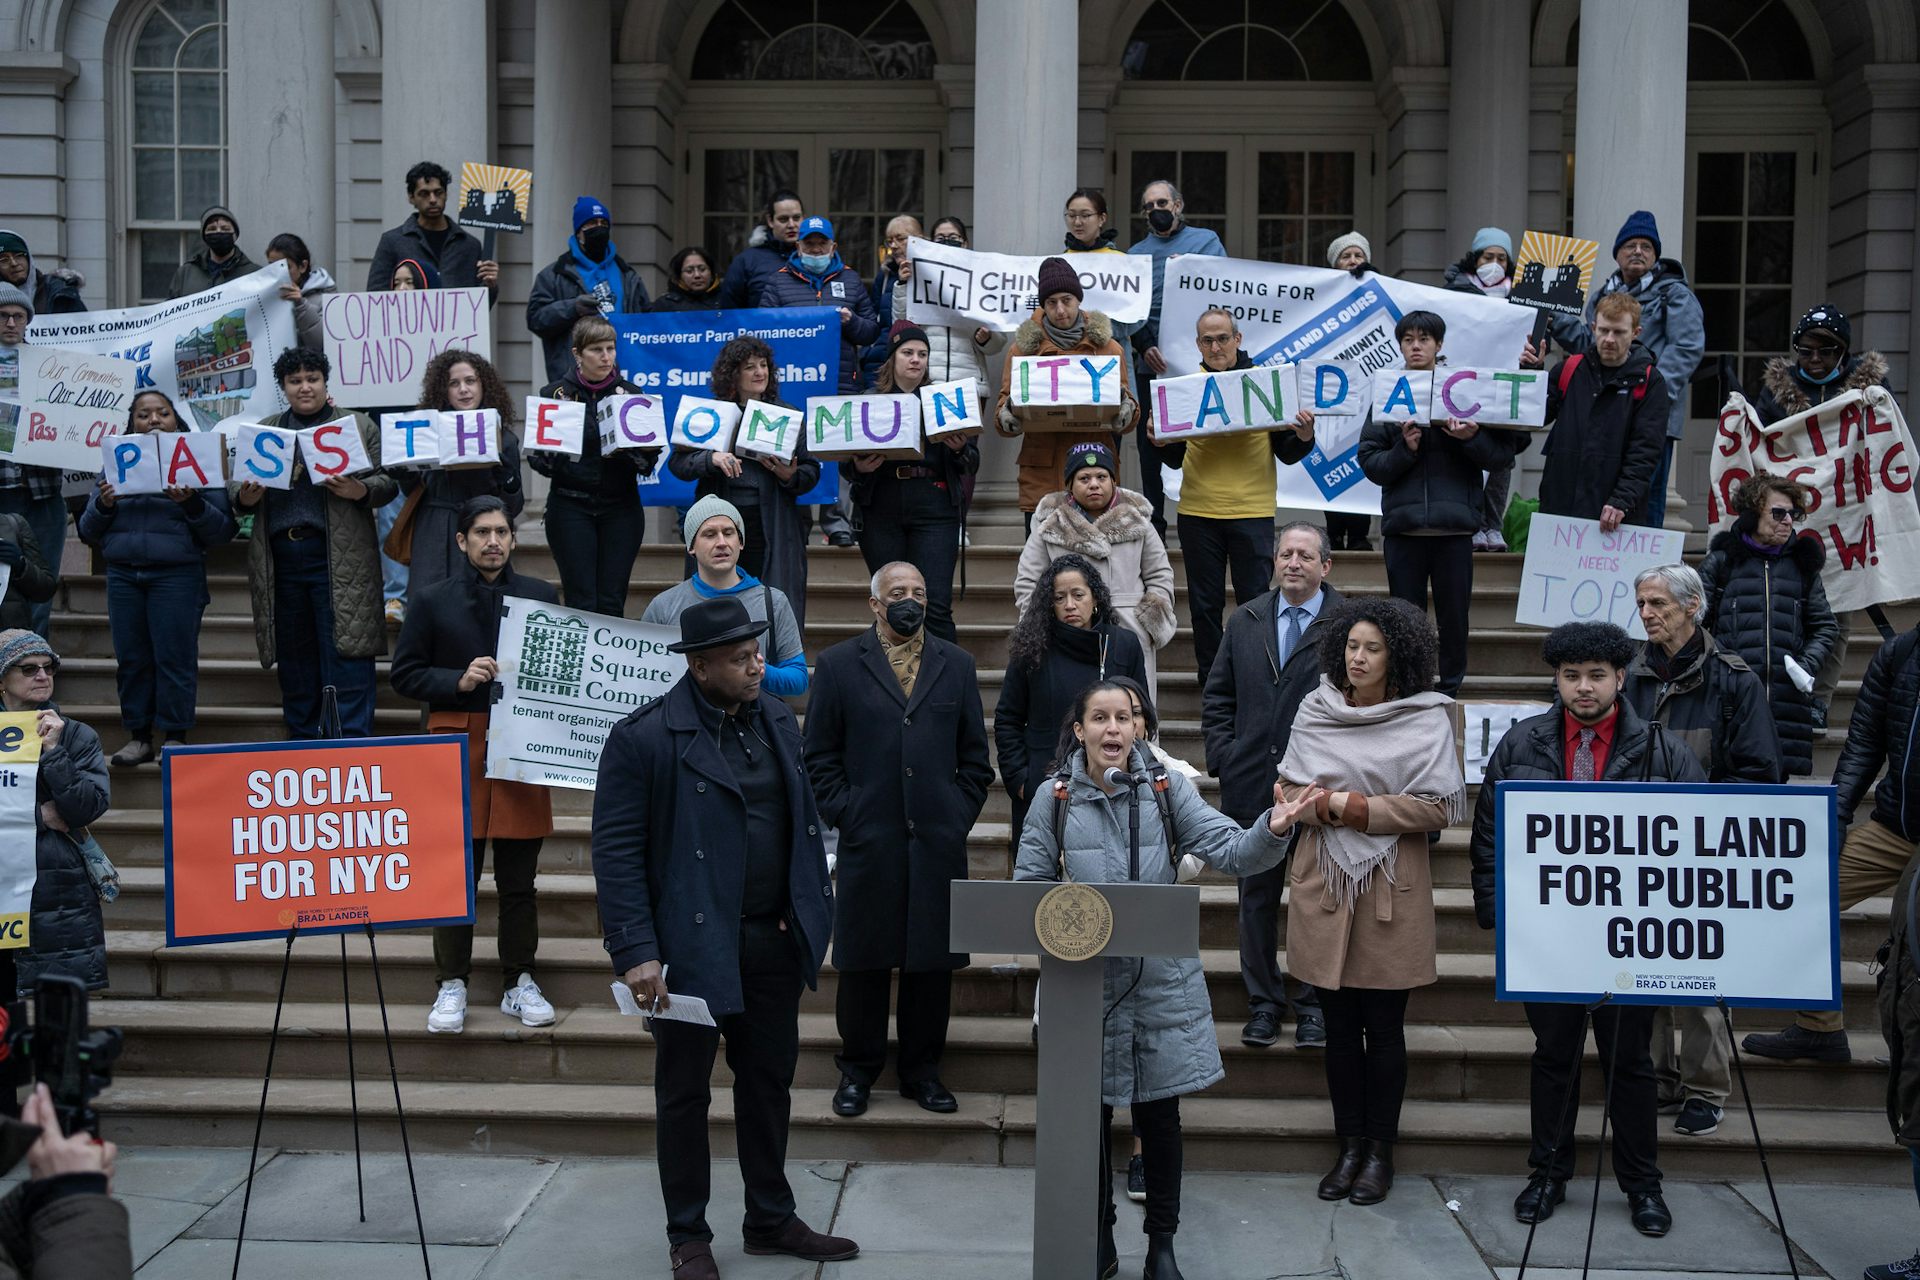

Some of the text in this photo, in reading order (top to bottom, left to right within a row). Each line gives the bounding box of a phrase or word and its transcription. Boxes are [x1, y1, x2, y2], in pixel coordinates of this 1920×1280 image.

[980, 271, 1141, 294] CHINOWN
[1179, 275, 1315, 301] HOUSING FOR
[30, 327, 60, 337] NEW
[62, 324, 96, 336] YORK
[98, 311, 165, 332] COMMUNITY
[164, 301, 190, 319] LAND
[191, 291, 223, 308] TRUST
[324, 289, 486, 341] COMMUNITY
[979, 294, 1021, 313] CLT
[1510, 295, 1581, 313] New Economy Project
[623, 332, 702, 345] “Perseverar
[705, 330, 735, 343] Para
[1283, 327, 1325, 359] LAND
[1321, 317, 1341, 334] IS
[1338, 290, 1378, 323] OURS
[38, 355, 69, 379] Our
[215, 355, 241, 370] CLT
[338, 337, 413, 385] LAND
[48, 381, 124, 410] Our LAND!
[28, 412, 58, 442] Pass
[65, 424, 79, 441] the
[64, 472, 96, 484] YORK
[1323, 462, 1354, 487] ESTA
[1553, 523, 1665, 555] NY STATE
[1797, 514, 1879, 571] OW!
[1577, 555, 1620, 572] NEEDS
[593, 627, 672, 658] Cooper
[590, 654, 672, 683] Square
[512, 705, 615, 729] tenant organizin
[526, 742, 599, 762] community
[247, 765, 392, 809] SOCIAL
[544, 771, 596, 786] www.coop
[231, 807, 410, 856] HOUSING
[1526, 813, 1807, 859] PUBLIC LAND
[234, 852, 411, 902] FOR NYC
[1539, 864, 1794, 911] FOR PUBLIC
[297, 911, 369, 923] BRAD LANDER
[1606, 916, 1725, 961] GOOD
[1636, 980, 1717, 990] BRAD LANDER
